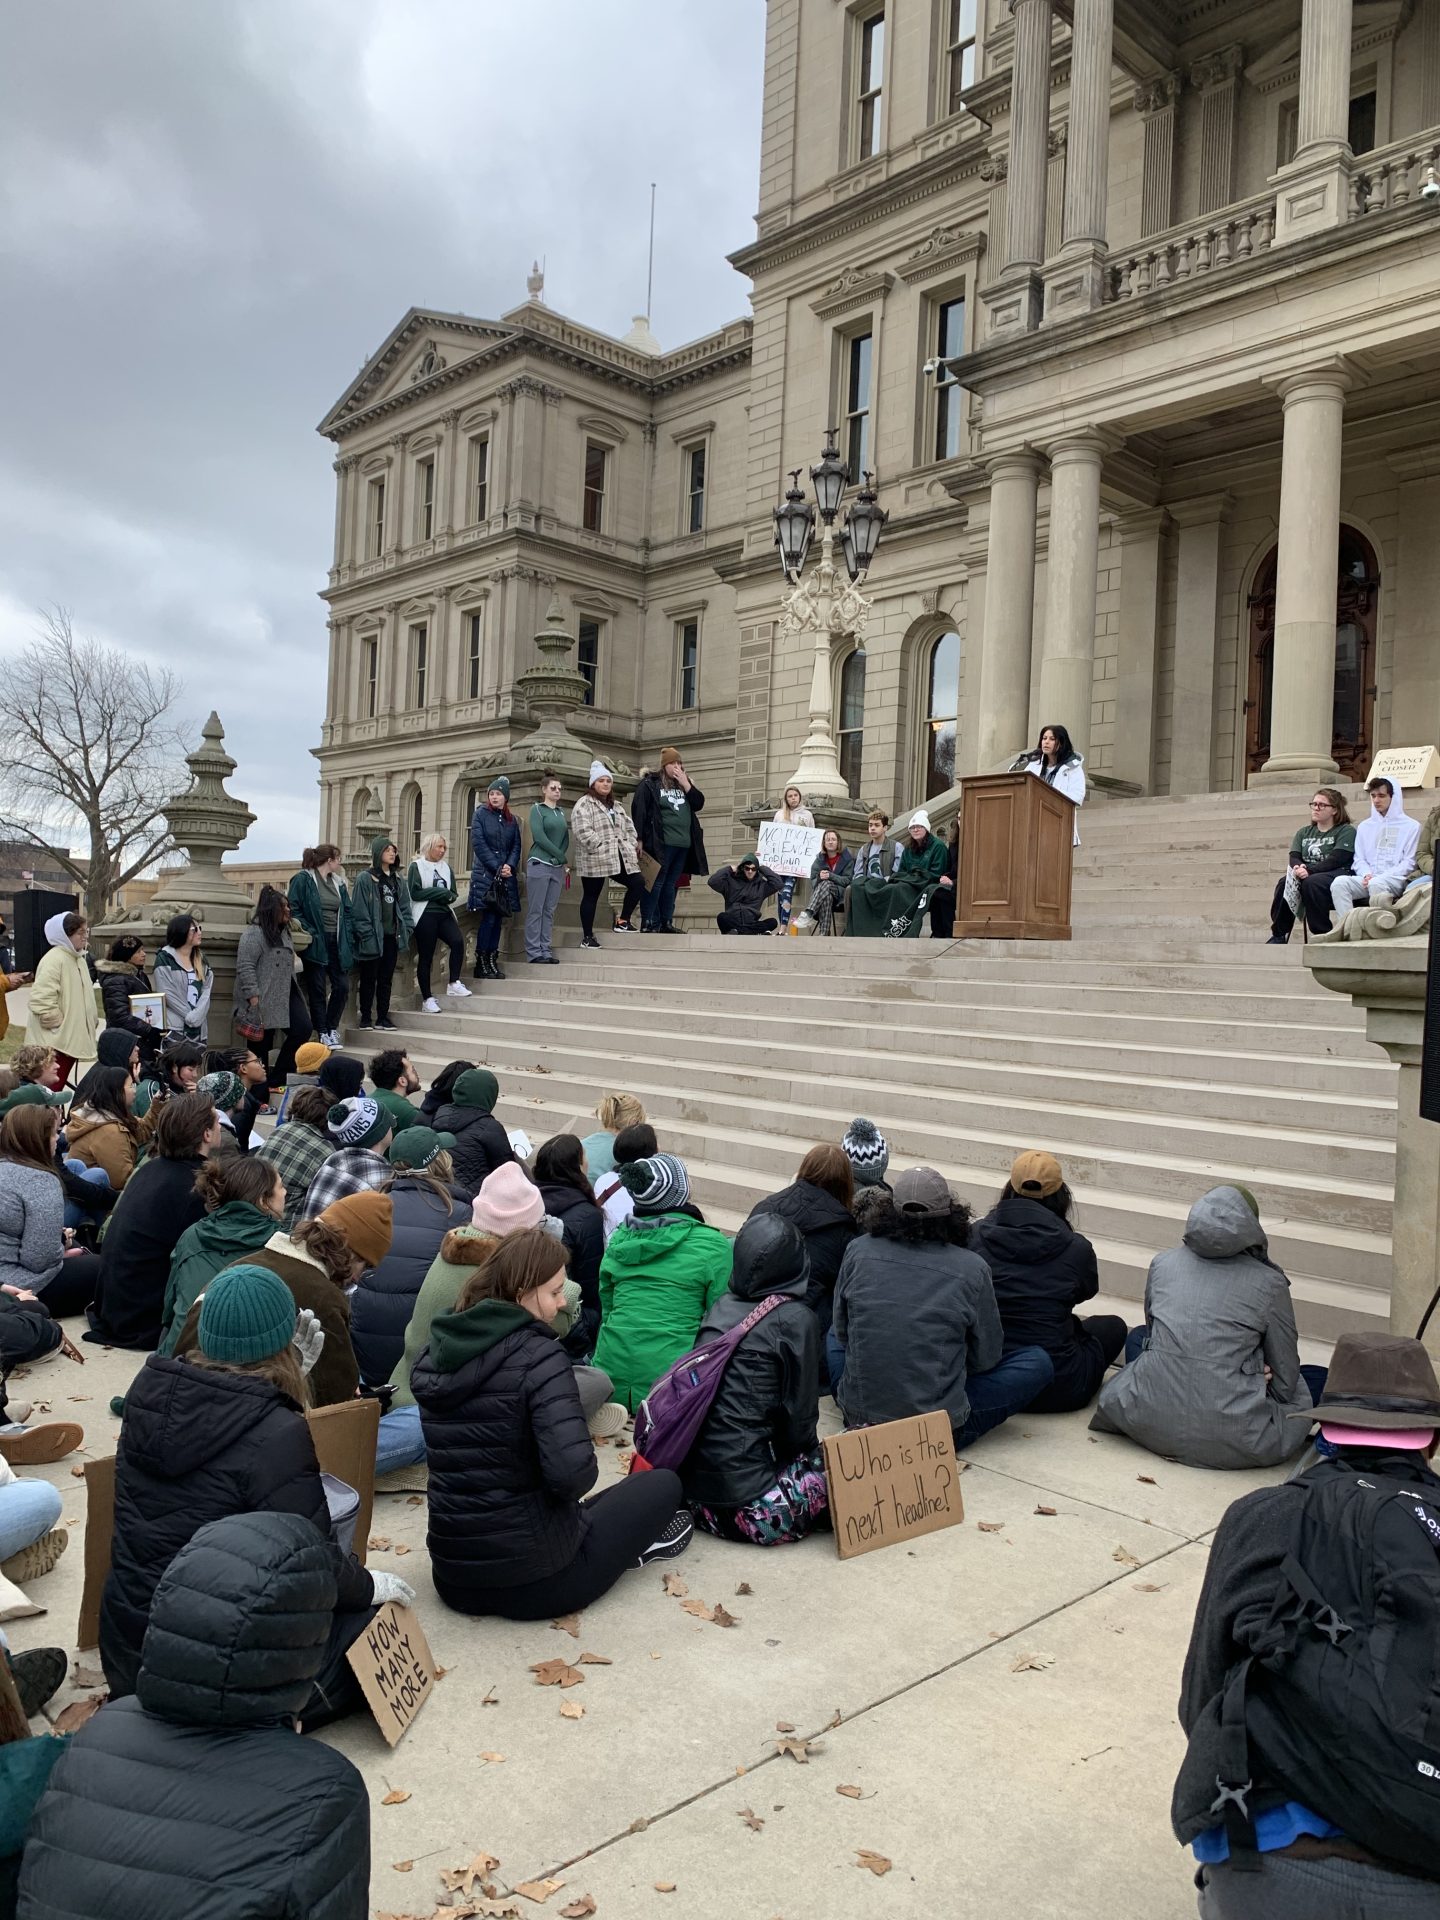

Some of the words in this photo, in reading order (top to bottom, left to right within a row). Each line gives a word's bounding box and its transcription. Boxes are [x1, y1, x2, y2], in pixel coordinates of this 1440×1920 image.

[1378, 757, 1423, 766] ENTRANCE
[760, 827, 783, 842] NO
[836, 1434, 892, 1482] Who
[898, 1445, 913, 1466] is
[916, 1421, 949, 1461] the
[846, 1485, 885, 1546] next
[891, 1464, 951, 1529] headline?
[366, 1608, 400, 1663] HOW
[375, 1634, 415, 1698] MANY
[390, 1661, 428, 1728] MORE
[1420, 1763, 1432, 1774] 30
